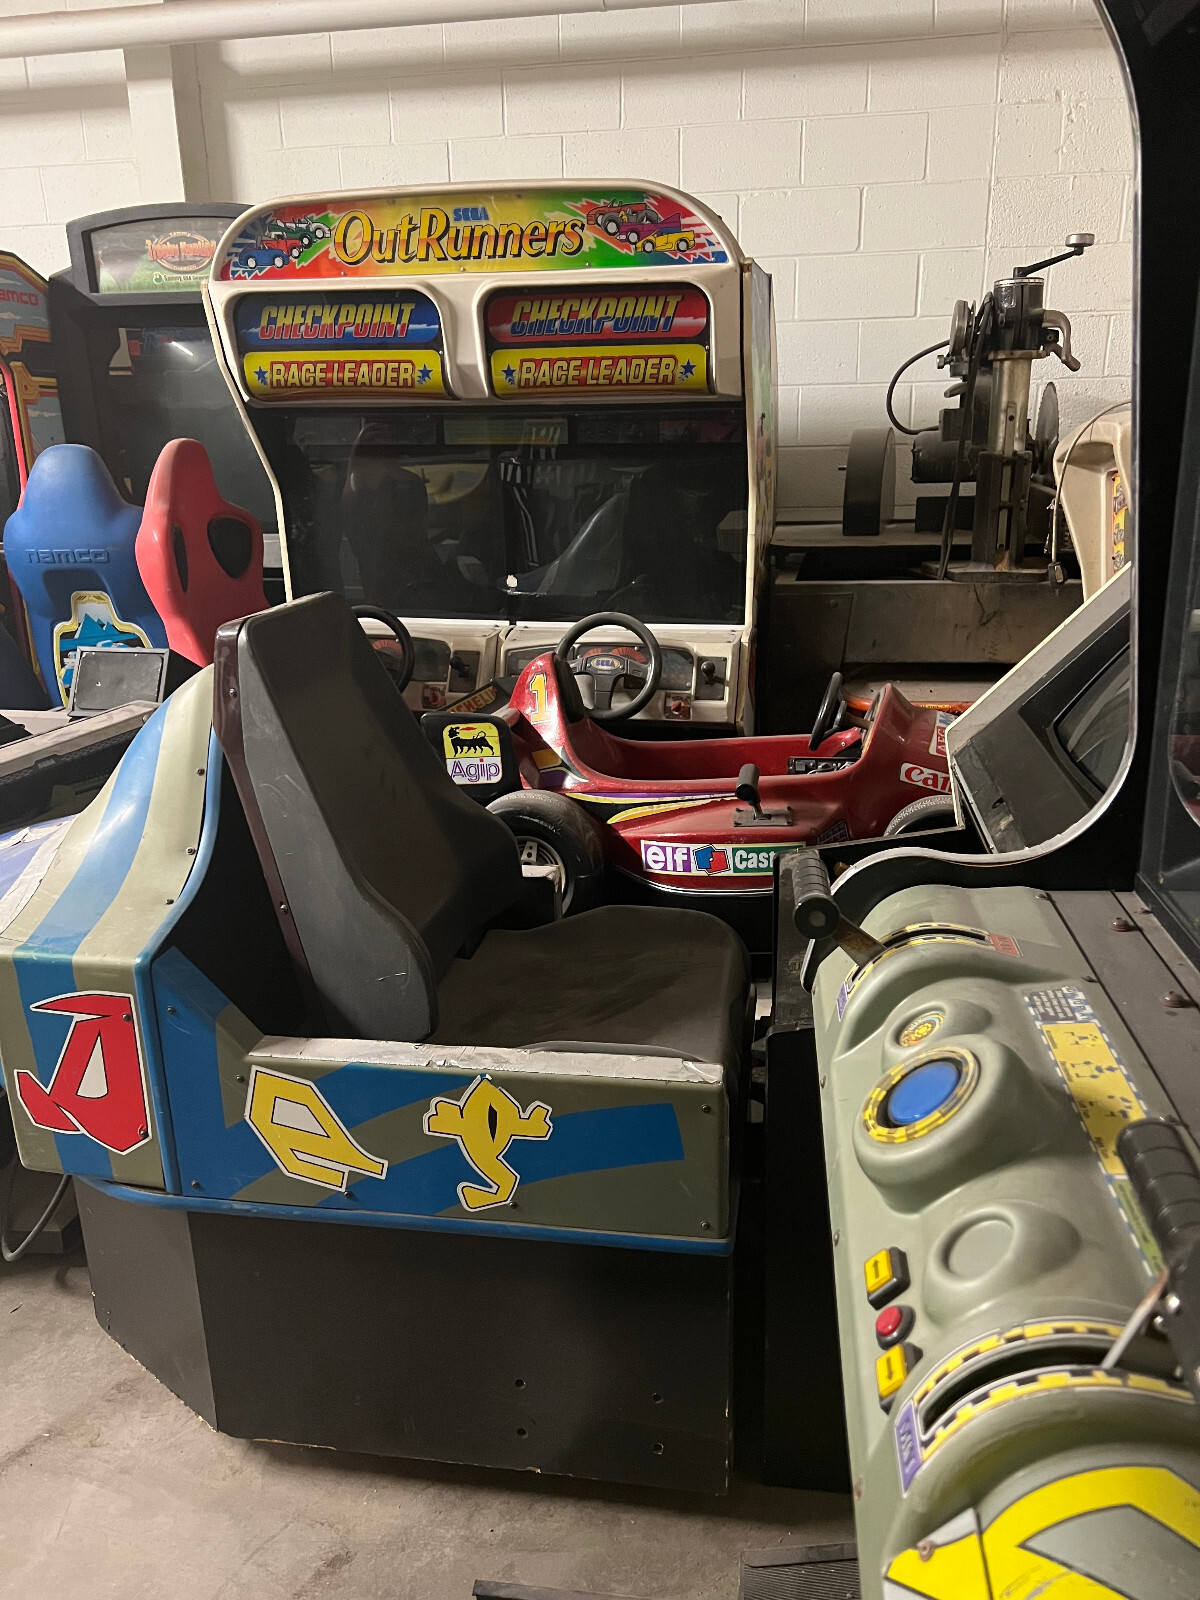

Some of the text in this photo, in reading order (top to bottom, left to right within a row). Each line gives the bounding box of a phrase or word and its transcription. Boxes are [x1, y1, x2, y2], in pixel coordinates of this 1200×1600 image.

[453, 207, 489, 221] SEGA
[334, 207, 584, 265] OutRunners
[258, 303, 415, 340] CHECKPOINT
[510, 295, 683, 337] CHECKPOINT
[271, 362, 414, 388] RACE LEADER
[519, 356, 677, 388] RACE LEADER
[28, 548, 110, 564] namco
[595, 659, 616, 667] SEGA
[529, 672, 550, 725] 1
[449, 758, 500, 783] Agip
[646, 845, 688, 872] elf
